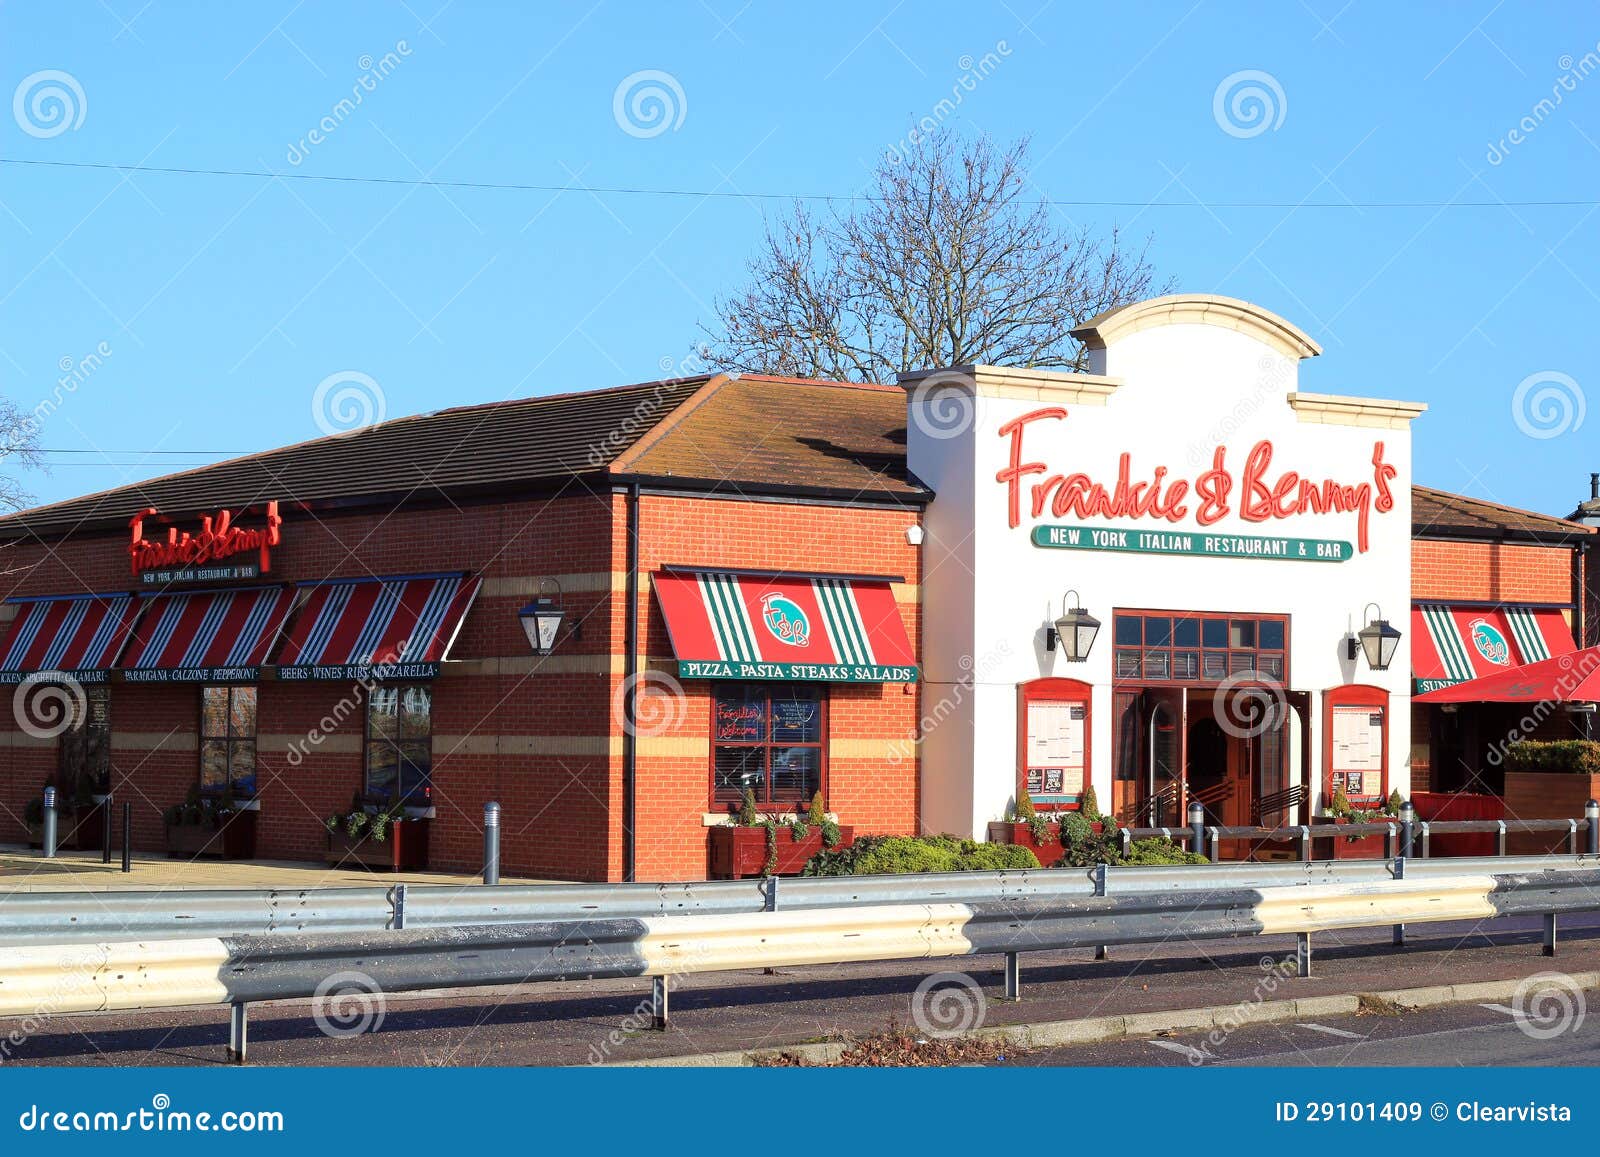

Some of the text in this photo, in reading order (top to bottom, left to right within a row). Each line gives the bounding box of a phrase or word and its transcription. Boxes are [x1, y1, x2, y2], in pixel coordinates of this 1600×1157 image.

[996, 407, 1398, 554] Frankie & Benny's
[1050, 527, 1341, 558] NEW YORK ITALIAN RESTAURANT & BAR
[143, 573, 155, 583] NEW
[158, 572, 171, 582] YORK
[198, 568, 231, 580] RESTAURANT
[65, 670, 104, 682] CALAMARI
[125, 668, 255, 681] PARMIGANA CALZONE PEPPERONI
[281, 665, 434, 679] BEERS WINES RIBS MOZZARELLA
[687, 663, 910, 681] PIZZA PASTA STEAKS SALADS
